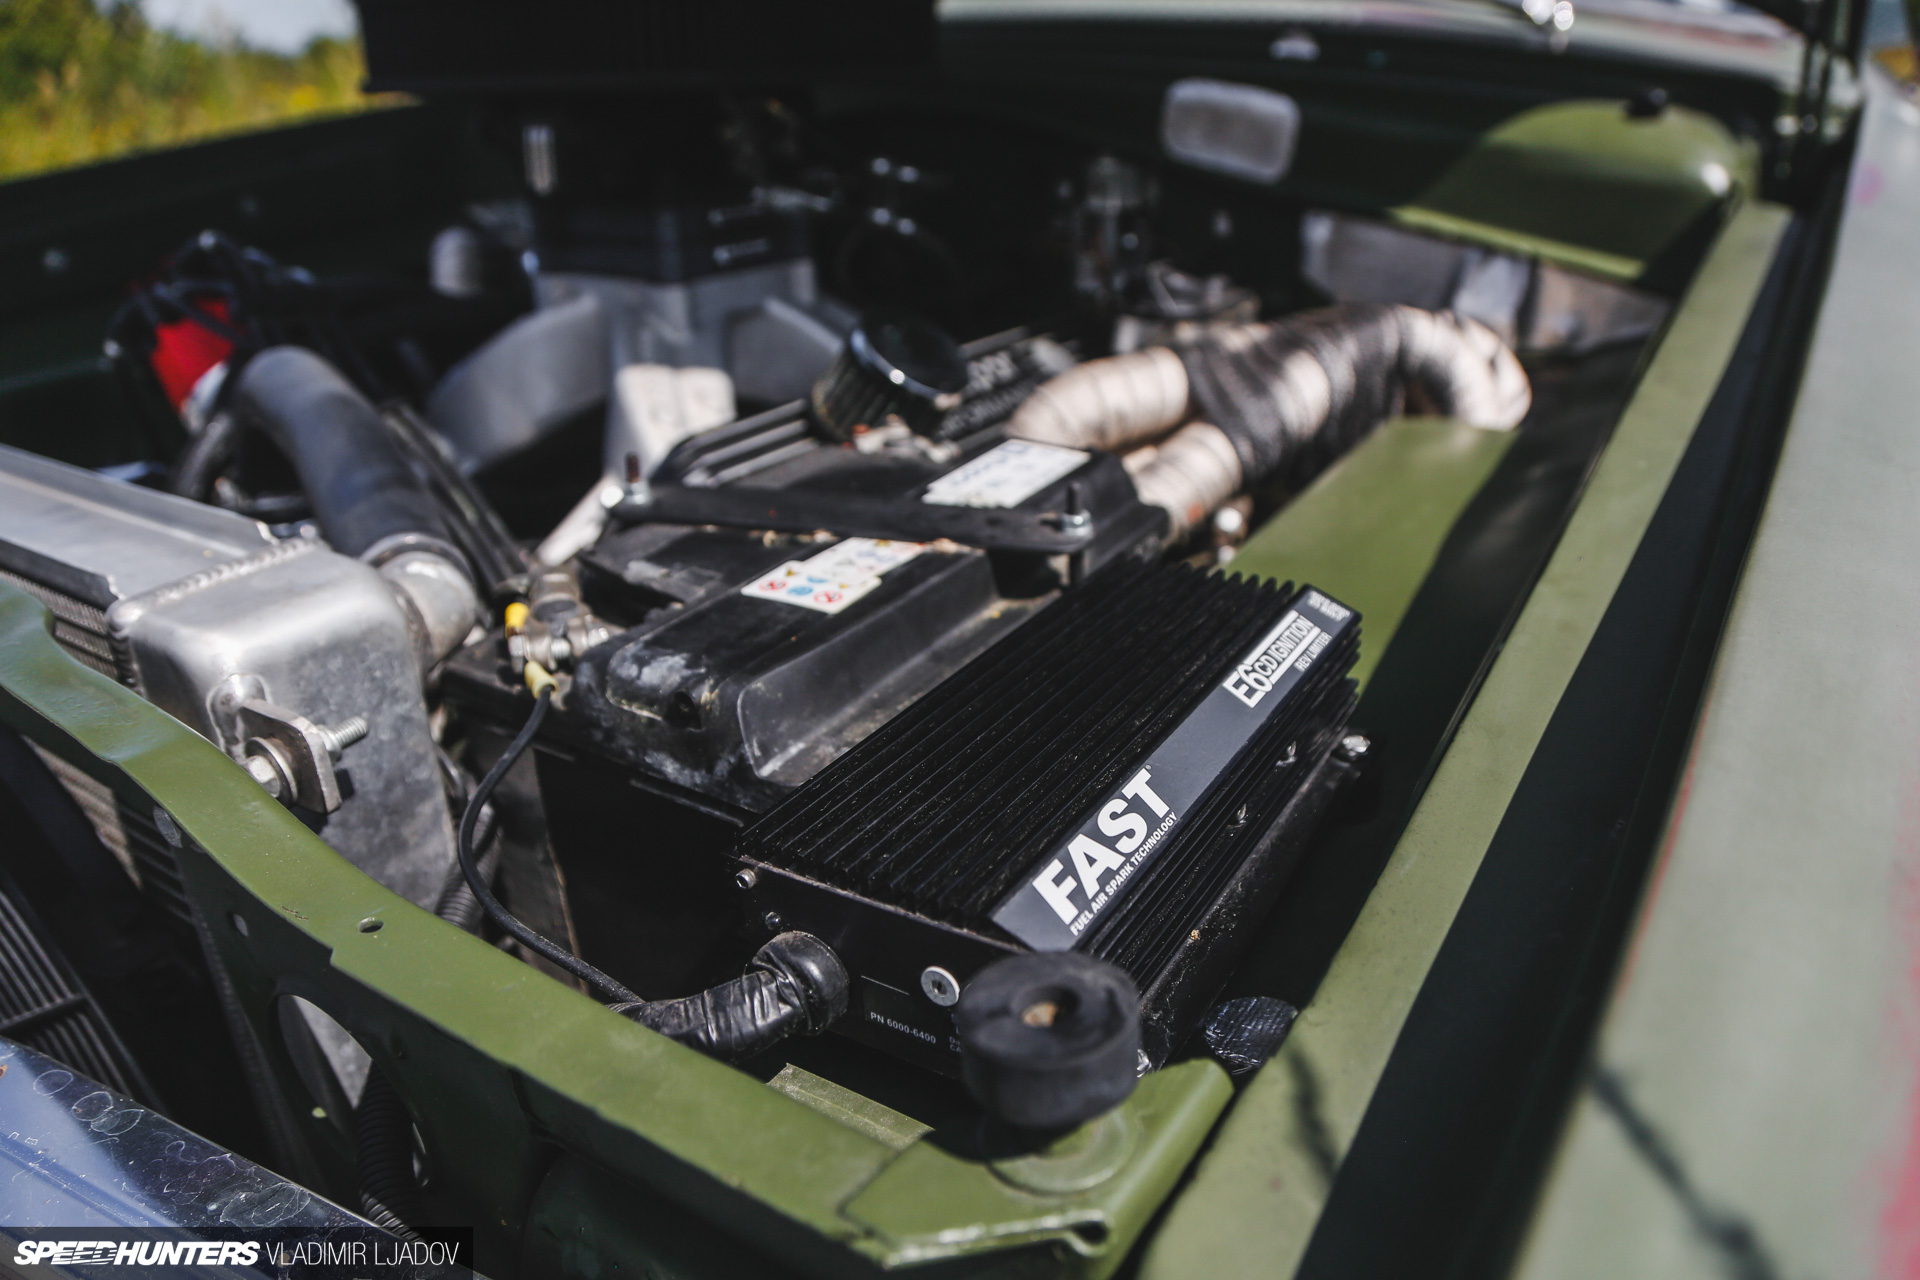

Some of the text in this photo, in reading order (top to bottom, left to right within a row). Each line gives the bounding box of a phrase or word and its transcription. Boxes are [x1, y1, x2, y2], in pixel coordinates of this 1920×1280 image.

[1222, 615, 1315, 709] E6 CD IGNITION
[1294, 653, 1313, 672] REV
[1308, 631, 1333, 659] LIMITER
[1032, 767, 1170, 926] FAST
[1069, 811, 1178, 937] FUEL AIR SPARK TECHNOLOGY
[870, 1011, 885, 1025] PN
[886, 1017, 937, 1044] 6000-6400
